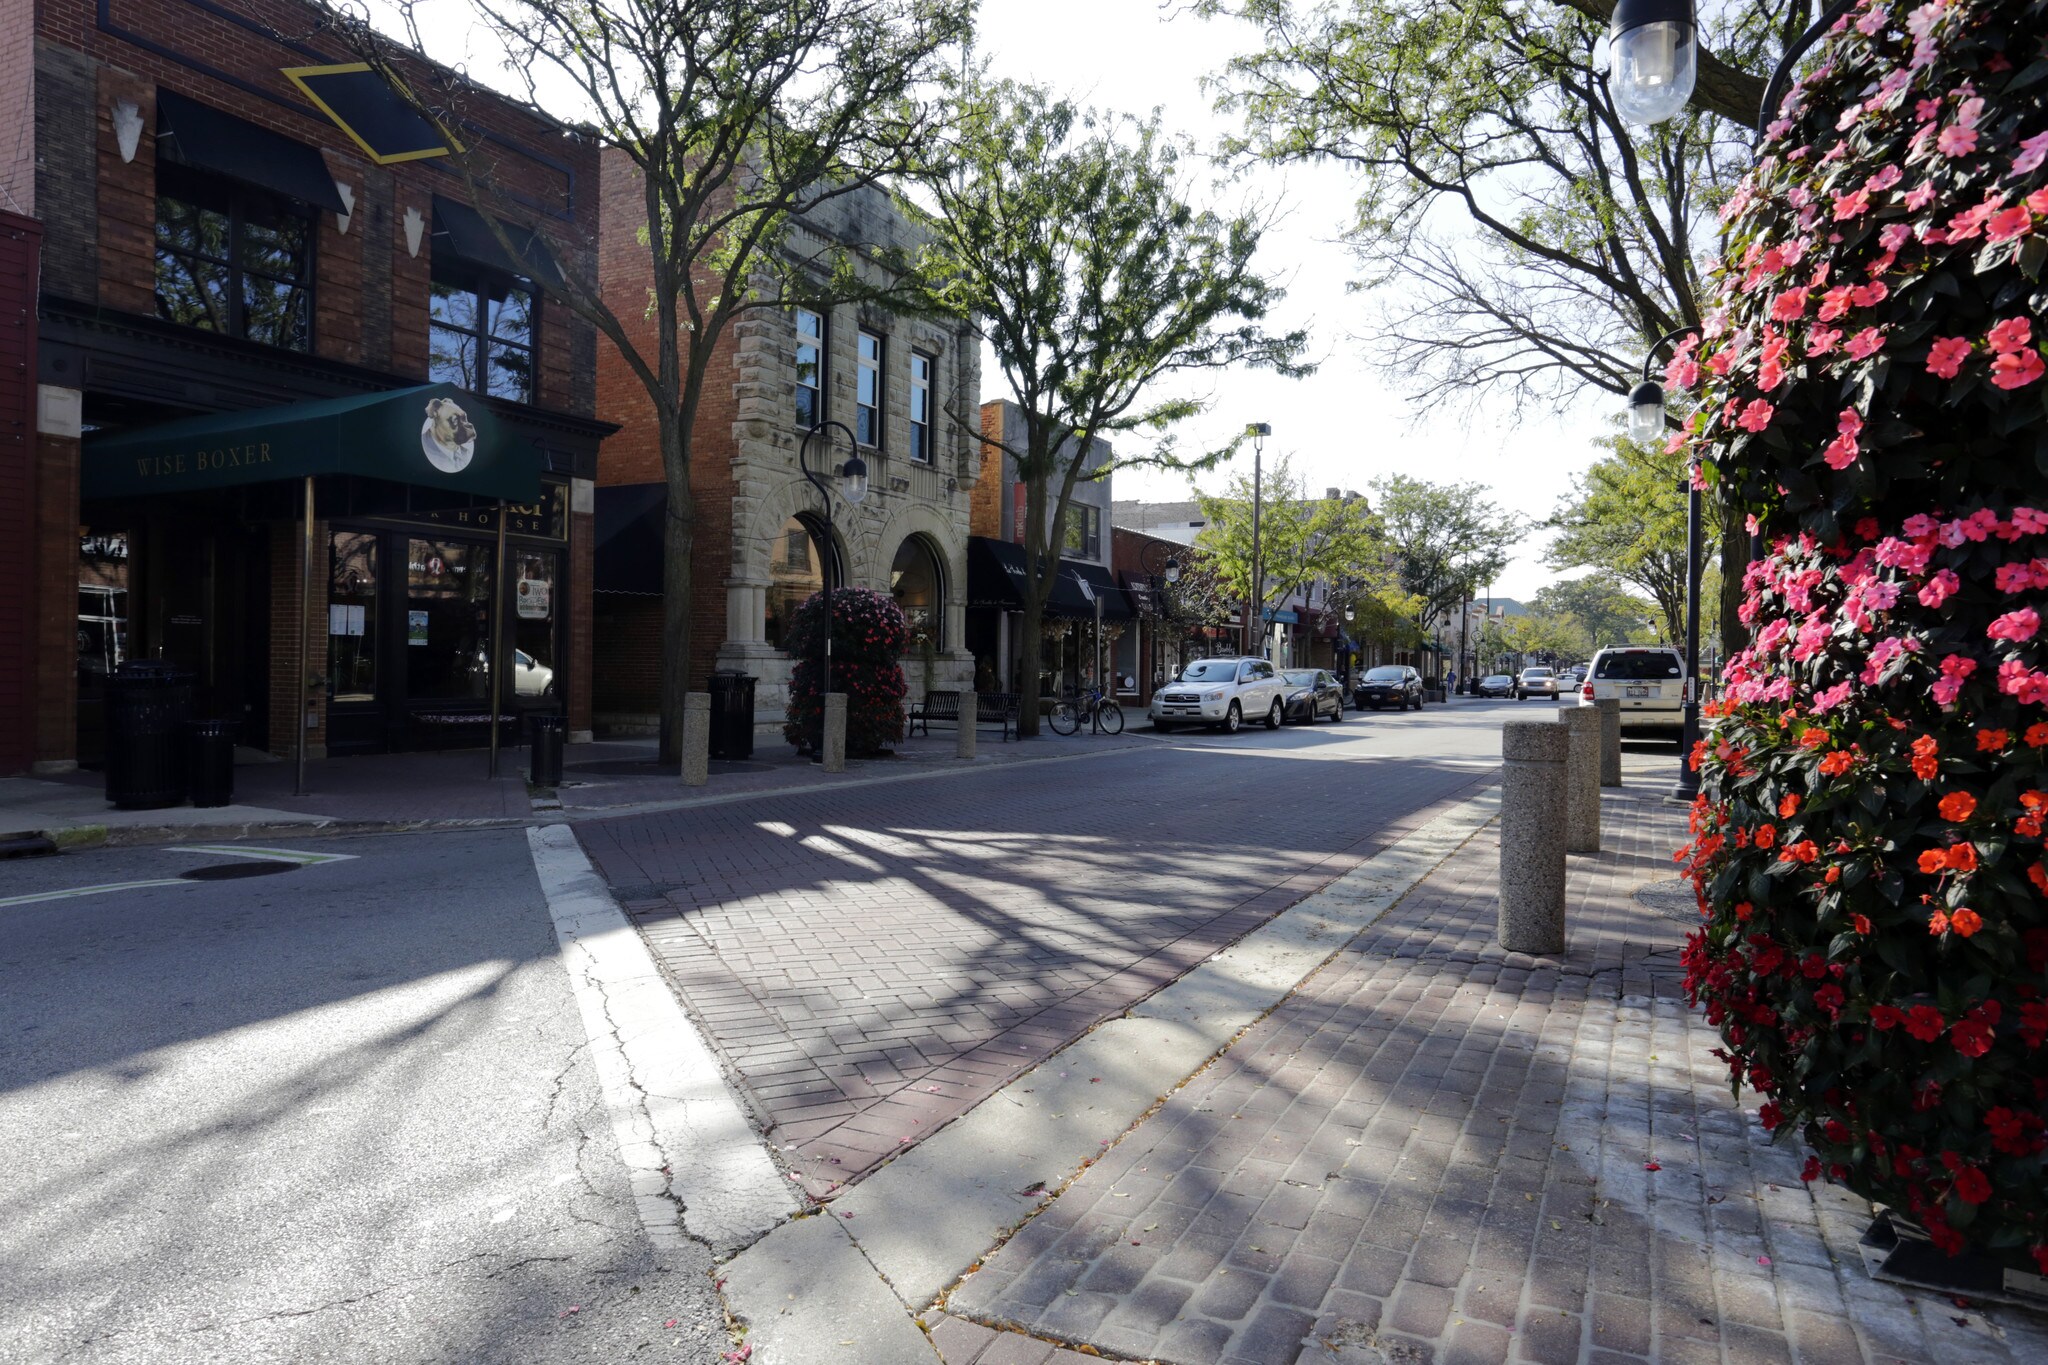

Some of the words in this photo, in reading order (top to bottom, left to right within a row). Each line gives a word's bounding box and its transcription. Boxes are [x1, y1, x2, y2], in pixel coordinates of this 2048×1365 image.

[136, 454, 187, 478] WISE
[197, 442, 273, 471] BOXER
[458, 511, 540, 531] HOSE
[1015, 505, 1024, 538] mklab
